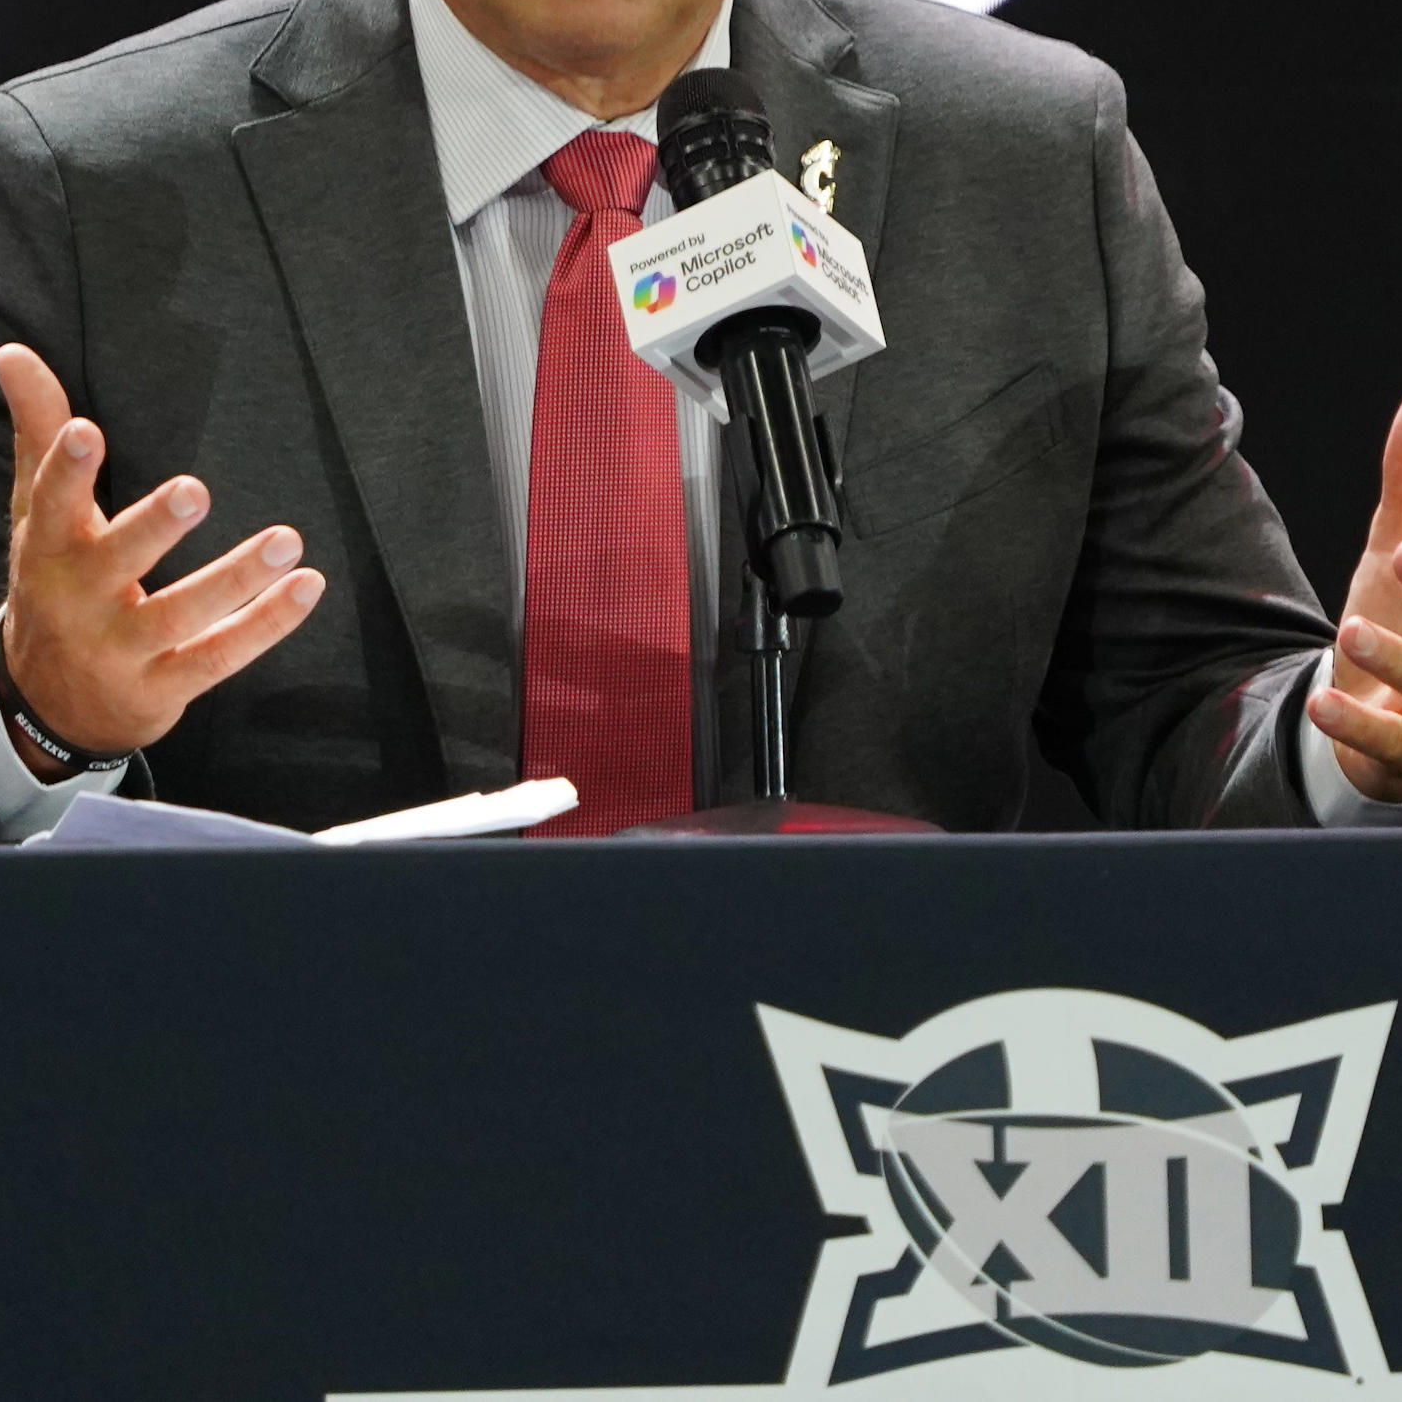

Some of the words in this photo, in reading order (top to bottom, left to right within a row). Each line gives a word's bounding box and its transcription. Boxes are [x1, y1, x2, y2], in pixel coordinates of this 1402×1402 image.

[630, 239, 687, 275] Powered
[689, 232, 707, 248] by
[680, 222, 775, 277] Microsoft
[685, 250, 757, 292] Copilot
[860, 1103, 1310, 1348] XII
